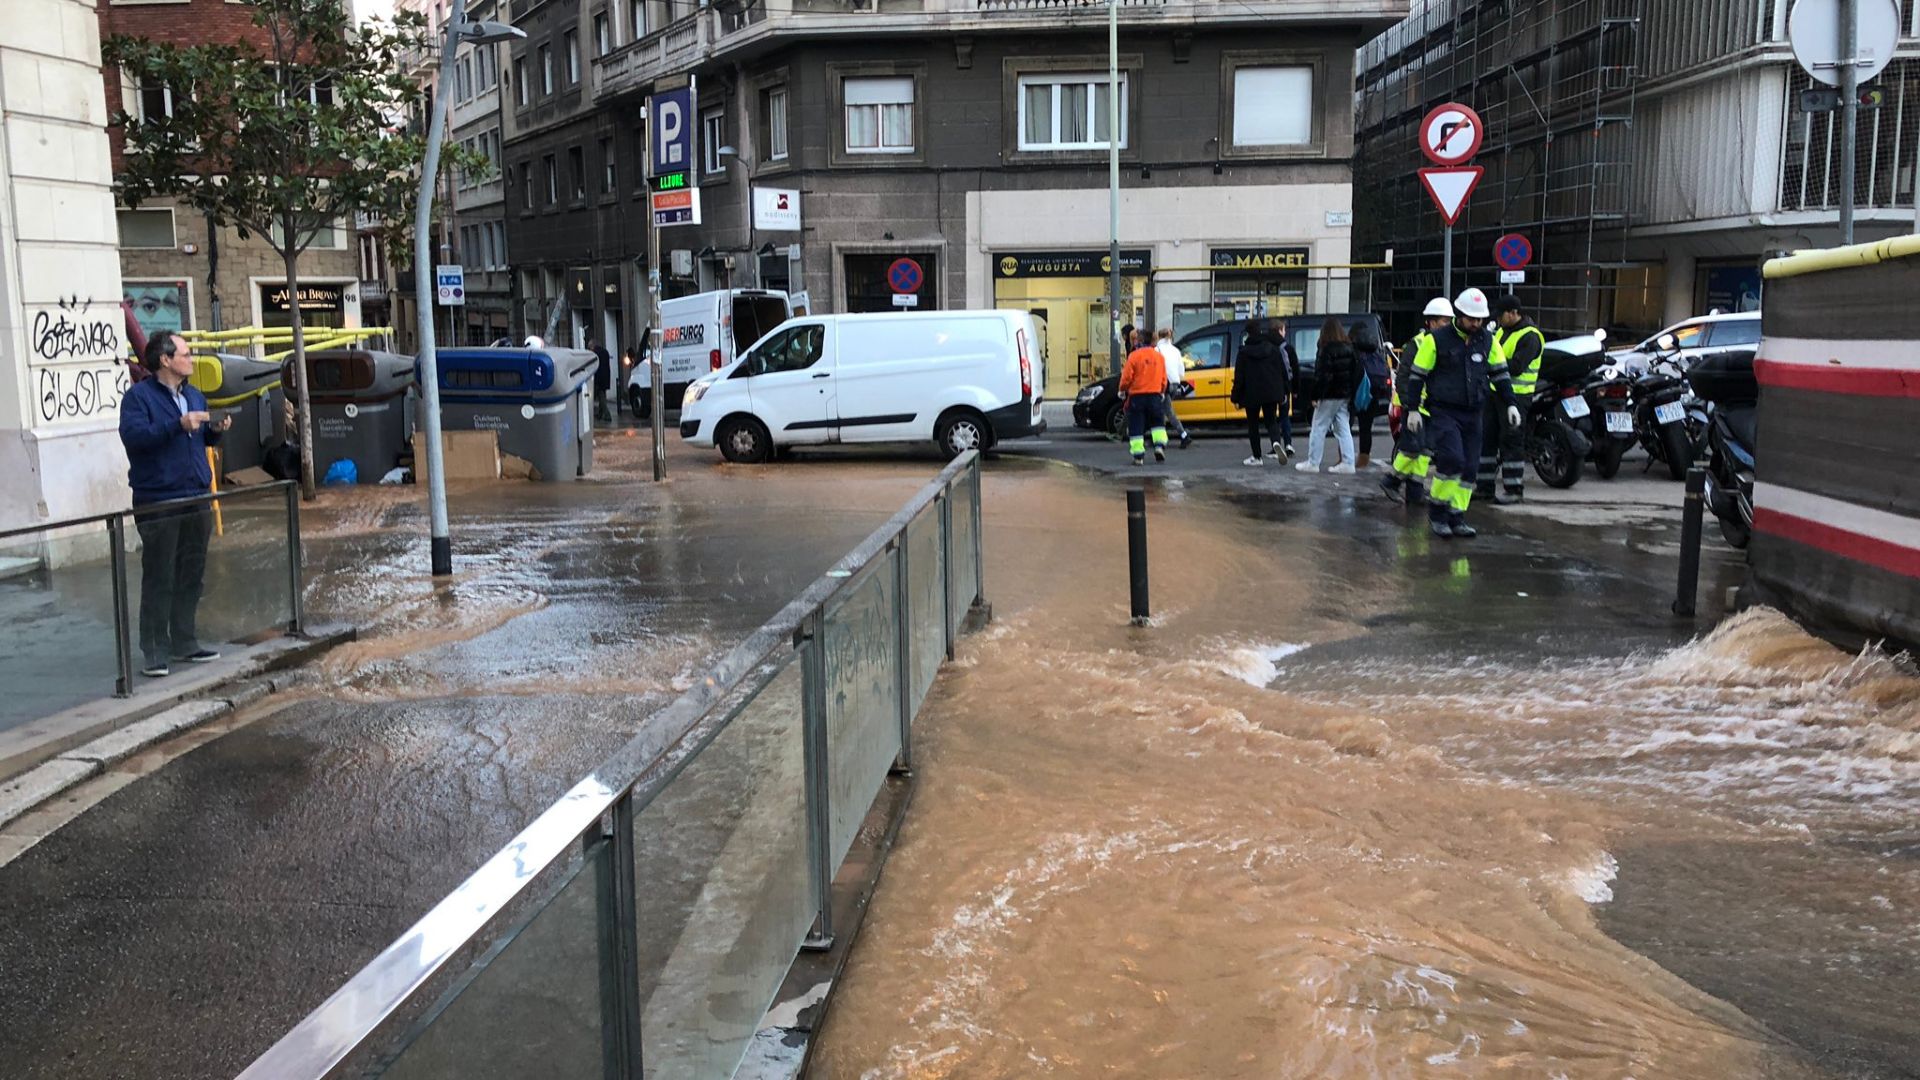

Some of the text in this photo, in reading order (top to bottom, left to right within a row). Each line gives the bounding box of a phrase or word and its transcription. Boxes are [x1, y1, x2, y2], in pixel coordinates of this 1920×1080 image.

[659, 100, 682, 165] P
[660, 174, 684, 189] LLIURE
[1236, 253, 1305, 268] MARCET
[1029, 264, 1081, 272] AUGUSTA
[345, 294, 357, 303] 98
[474, 421, 510, 429] Barcelona
